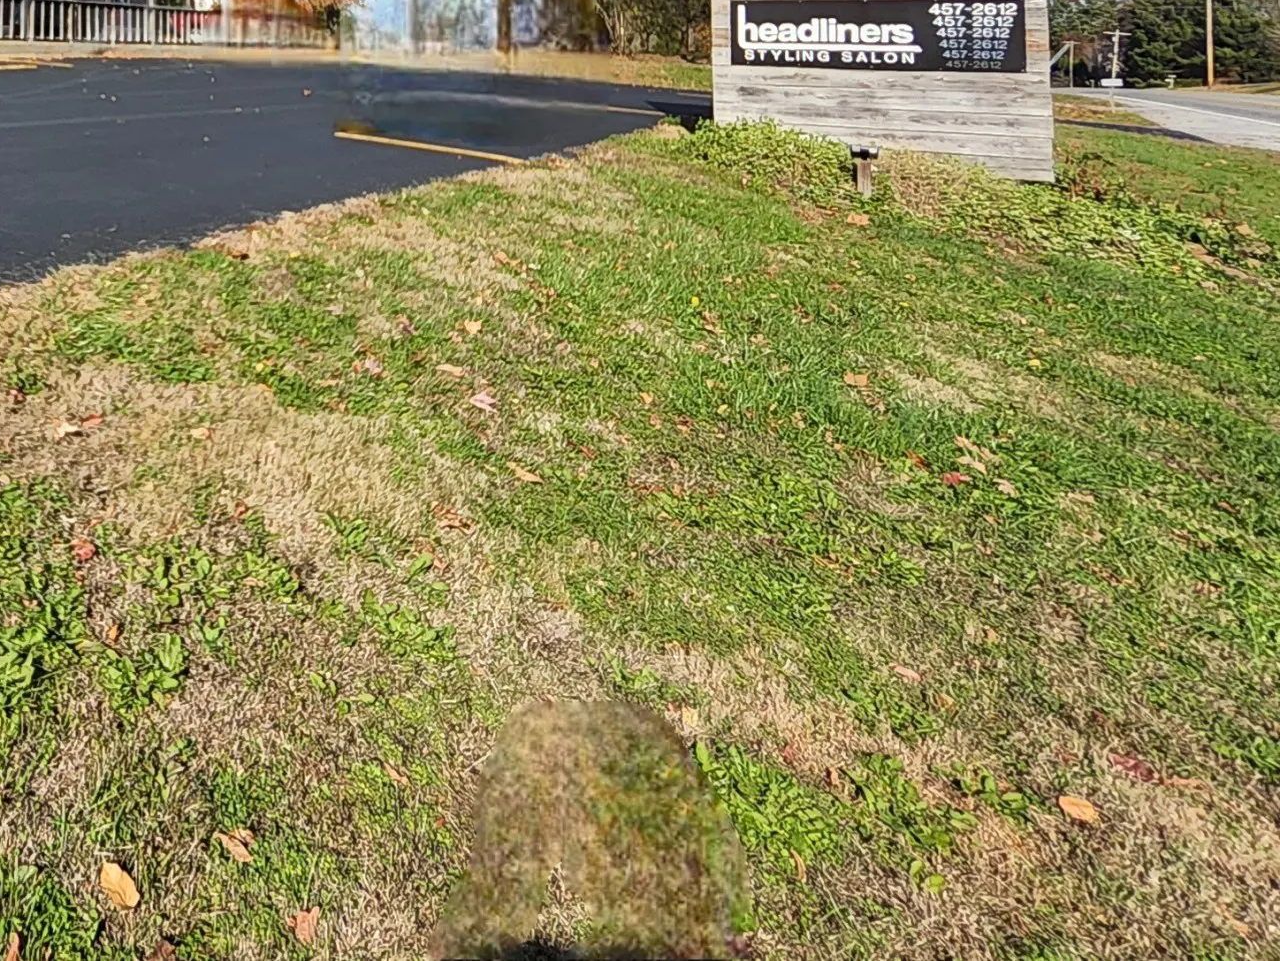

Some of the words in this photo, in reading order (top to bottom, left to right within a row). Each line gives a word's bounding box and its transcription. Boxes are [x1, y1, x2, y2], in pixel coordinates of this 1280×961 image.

[928, 2, 1018, 16] 457-2612
[932, 16, 1014, 27] 457-2612
[737, 4, 920, 51] headliners
[936, 27, 1010, 38] 457-2612
[939, 39, 1008, 50] 457-2612
[744, 49, 830, 63] STYLING
[841, 50, 915, 65] SALON
[942, 50, 1005, 60] 457-2612
[945, 60, 1002, 69] 457-2612
